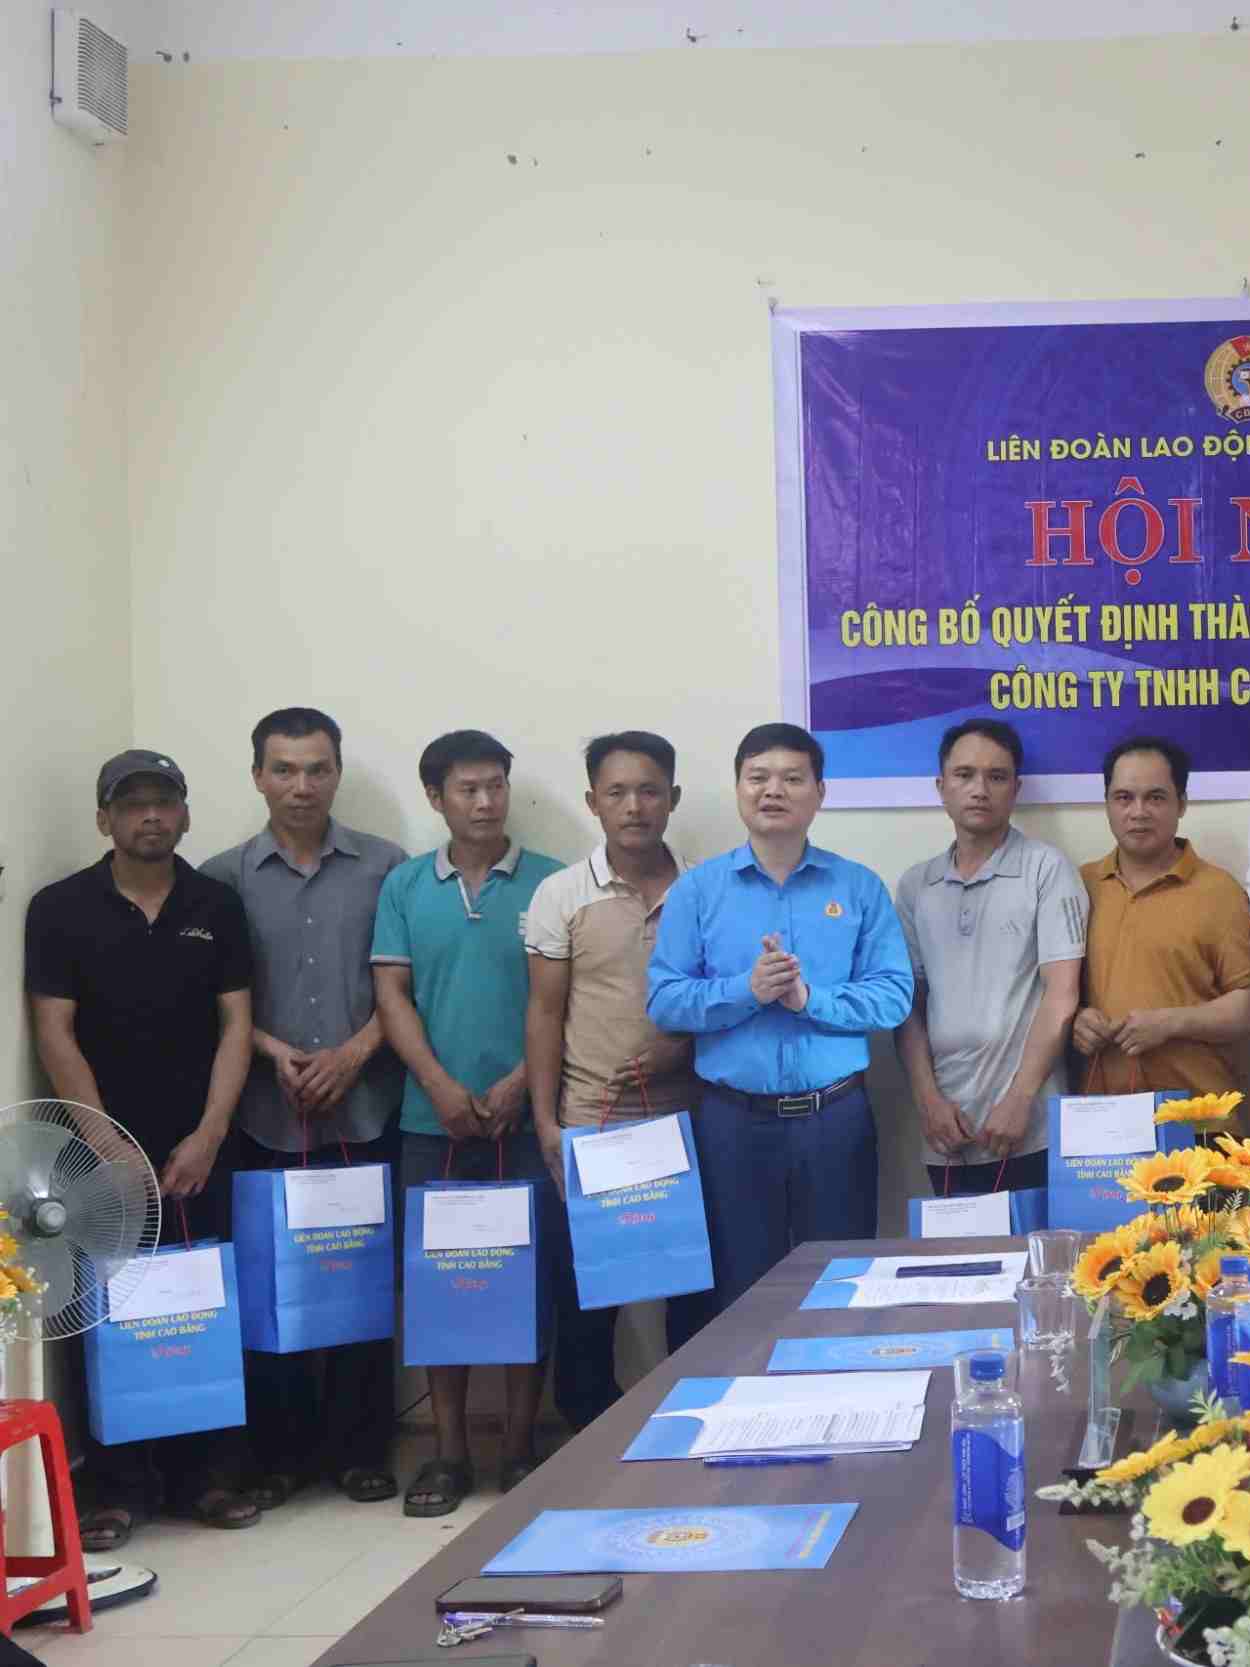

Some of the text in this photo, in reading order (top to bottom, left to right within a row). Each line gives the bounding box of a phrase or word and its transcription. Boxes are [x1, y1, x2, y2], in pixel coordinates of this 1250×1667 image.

[987, 434, 1040, 462] LIÊN
[1050, 431, 1131, 460] ĐOÀN
[1141, 435, 1194, 458] LAO
[1024, 475, 1203, 586] HỘI
[841, 601, 928, 647] CÔNG
[938, 594, 982, 645] BỐ
[991, 593, 1091, 648] QUYẾT
[1101, 604, 1179, 650] ĐỊNH
[990, 664, 1078, 710] CÔNG
[1088, 671, 1125, 708] TY
[1135, 667, 1220, 706] TNHH
